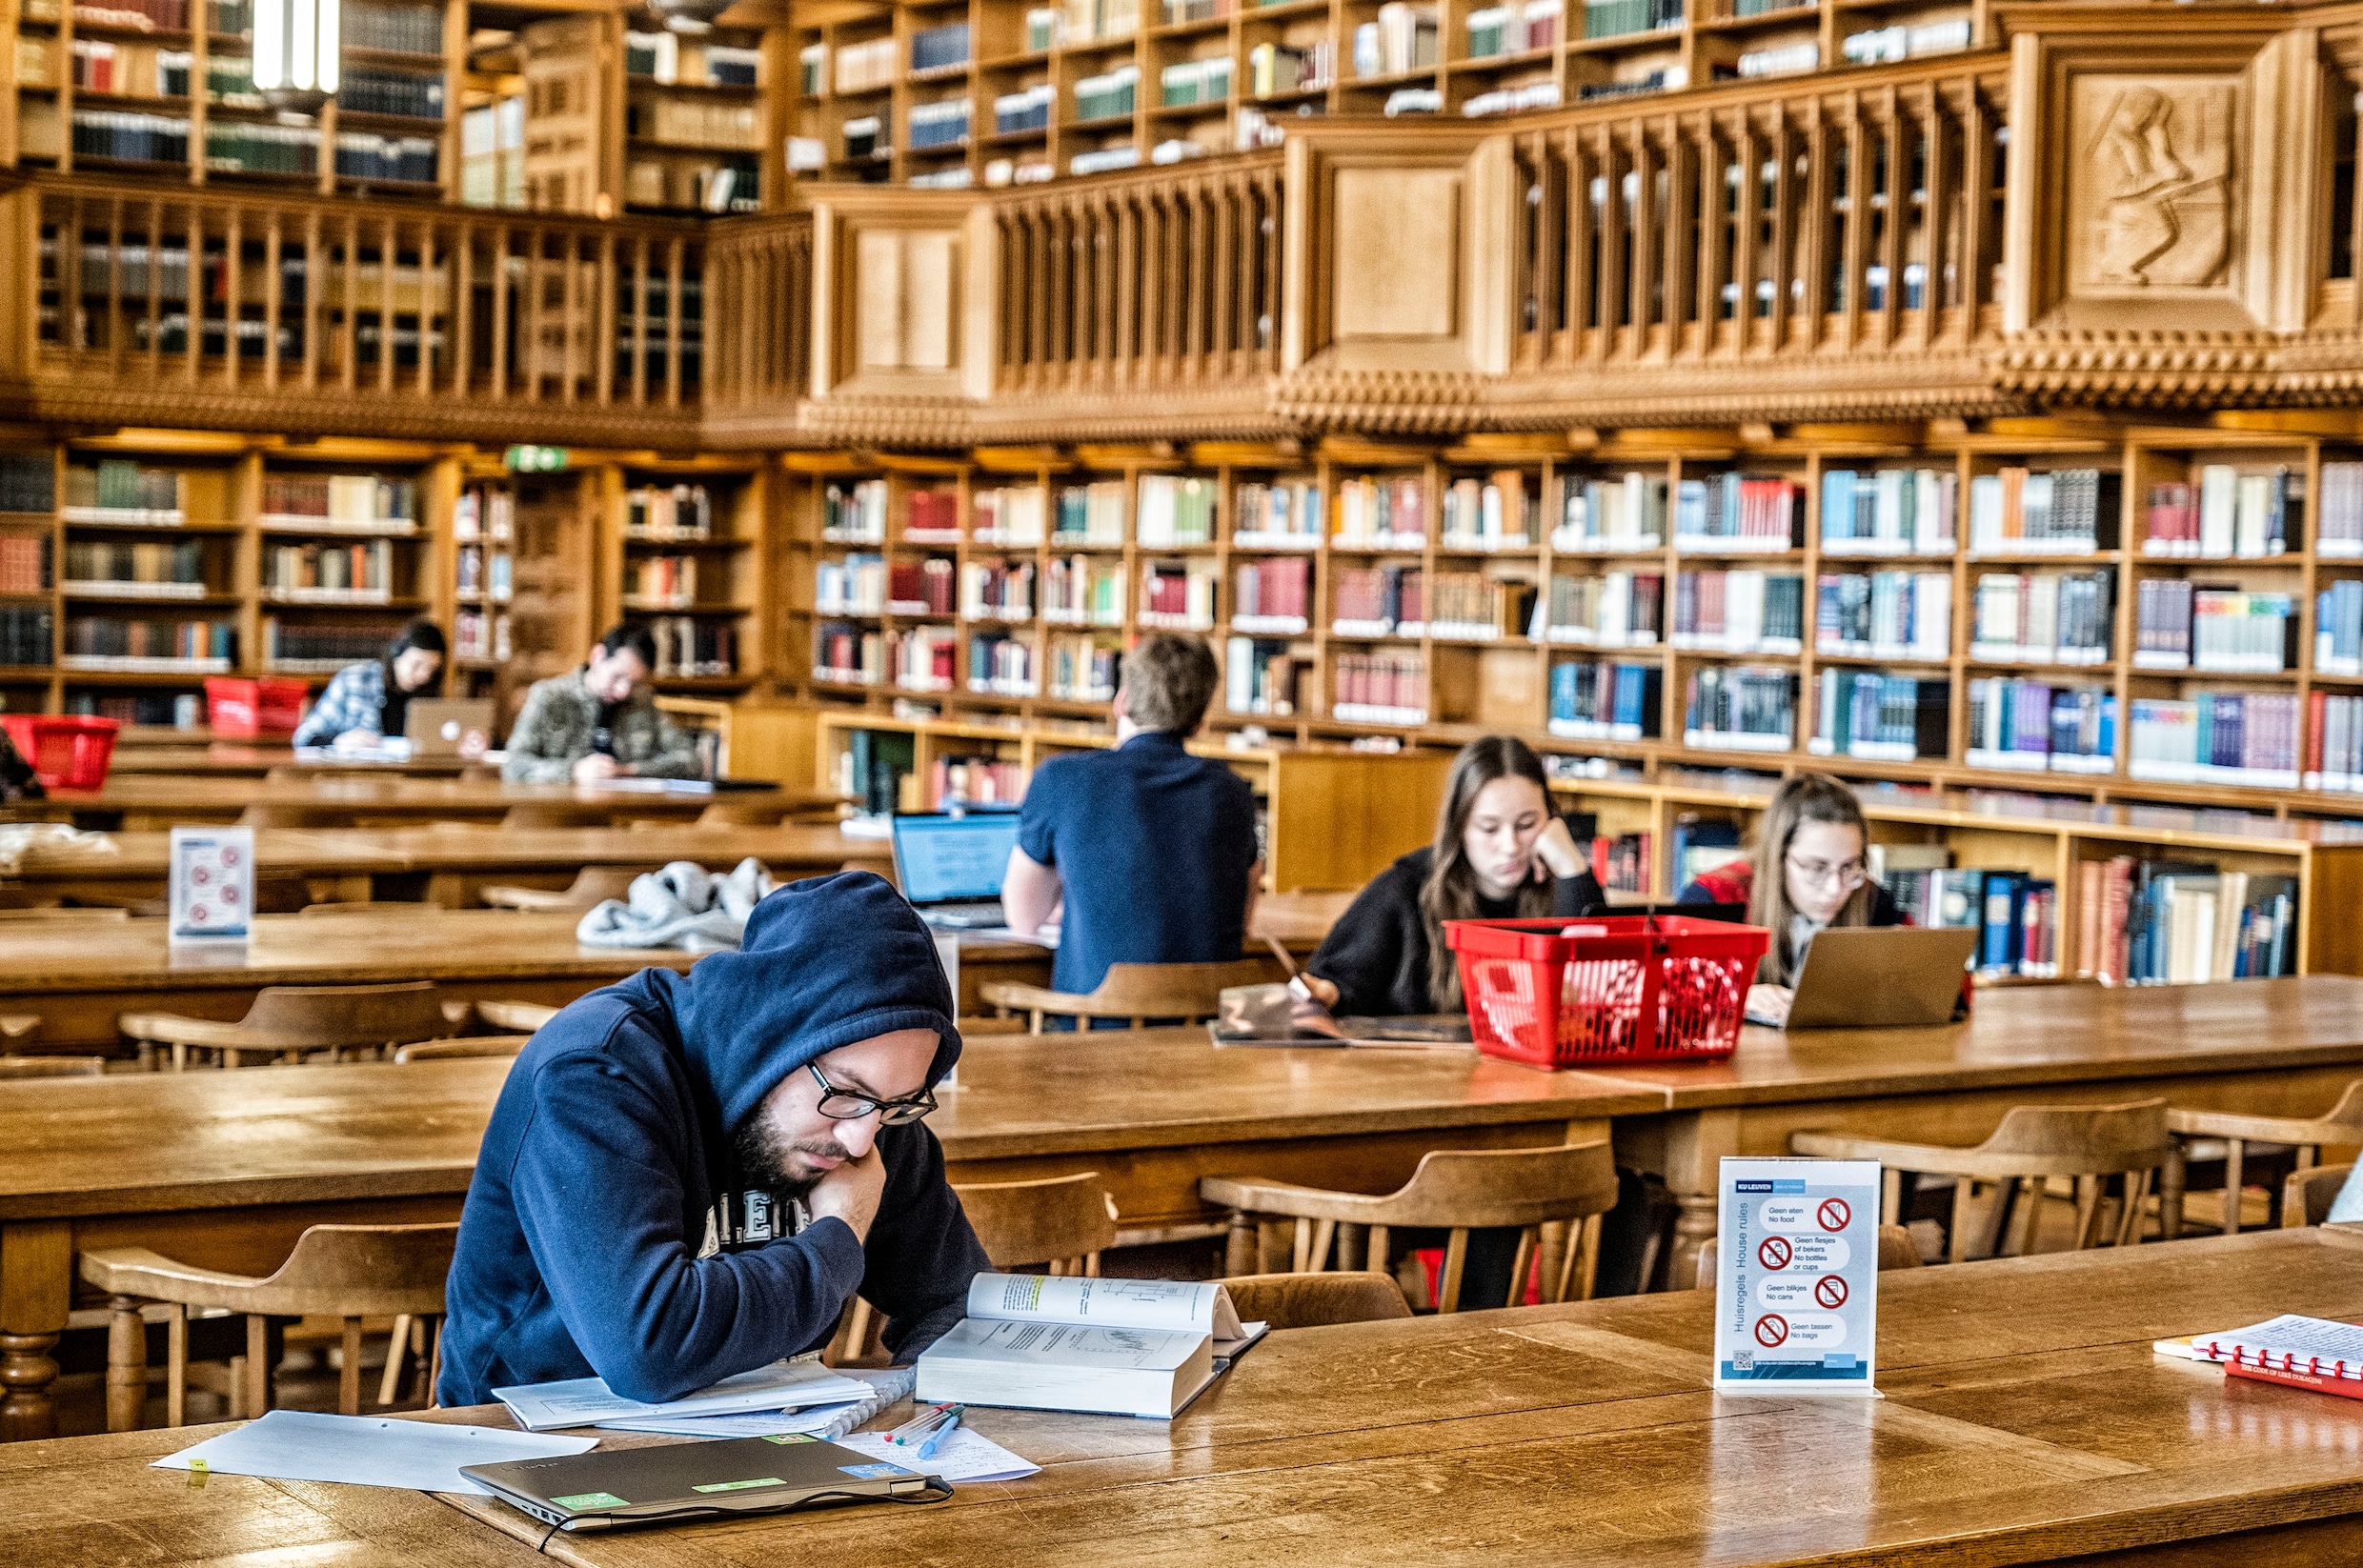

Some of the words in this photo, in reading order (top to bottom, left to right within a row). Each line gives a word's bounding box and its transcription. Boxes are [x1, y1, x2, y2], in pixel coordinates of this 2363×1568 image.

[1737, 1202, 1748, 1230] rules
[1814, 1236, 1836, 1245] flesjes
[1736, 1232, 1747, 1268] House
[1787, 1284, 1808, 1293] blikjes
[1734, 1274, 1748, 1333] Huisregels
[1802, 1332, 1818, 1340] bags
